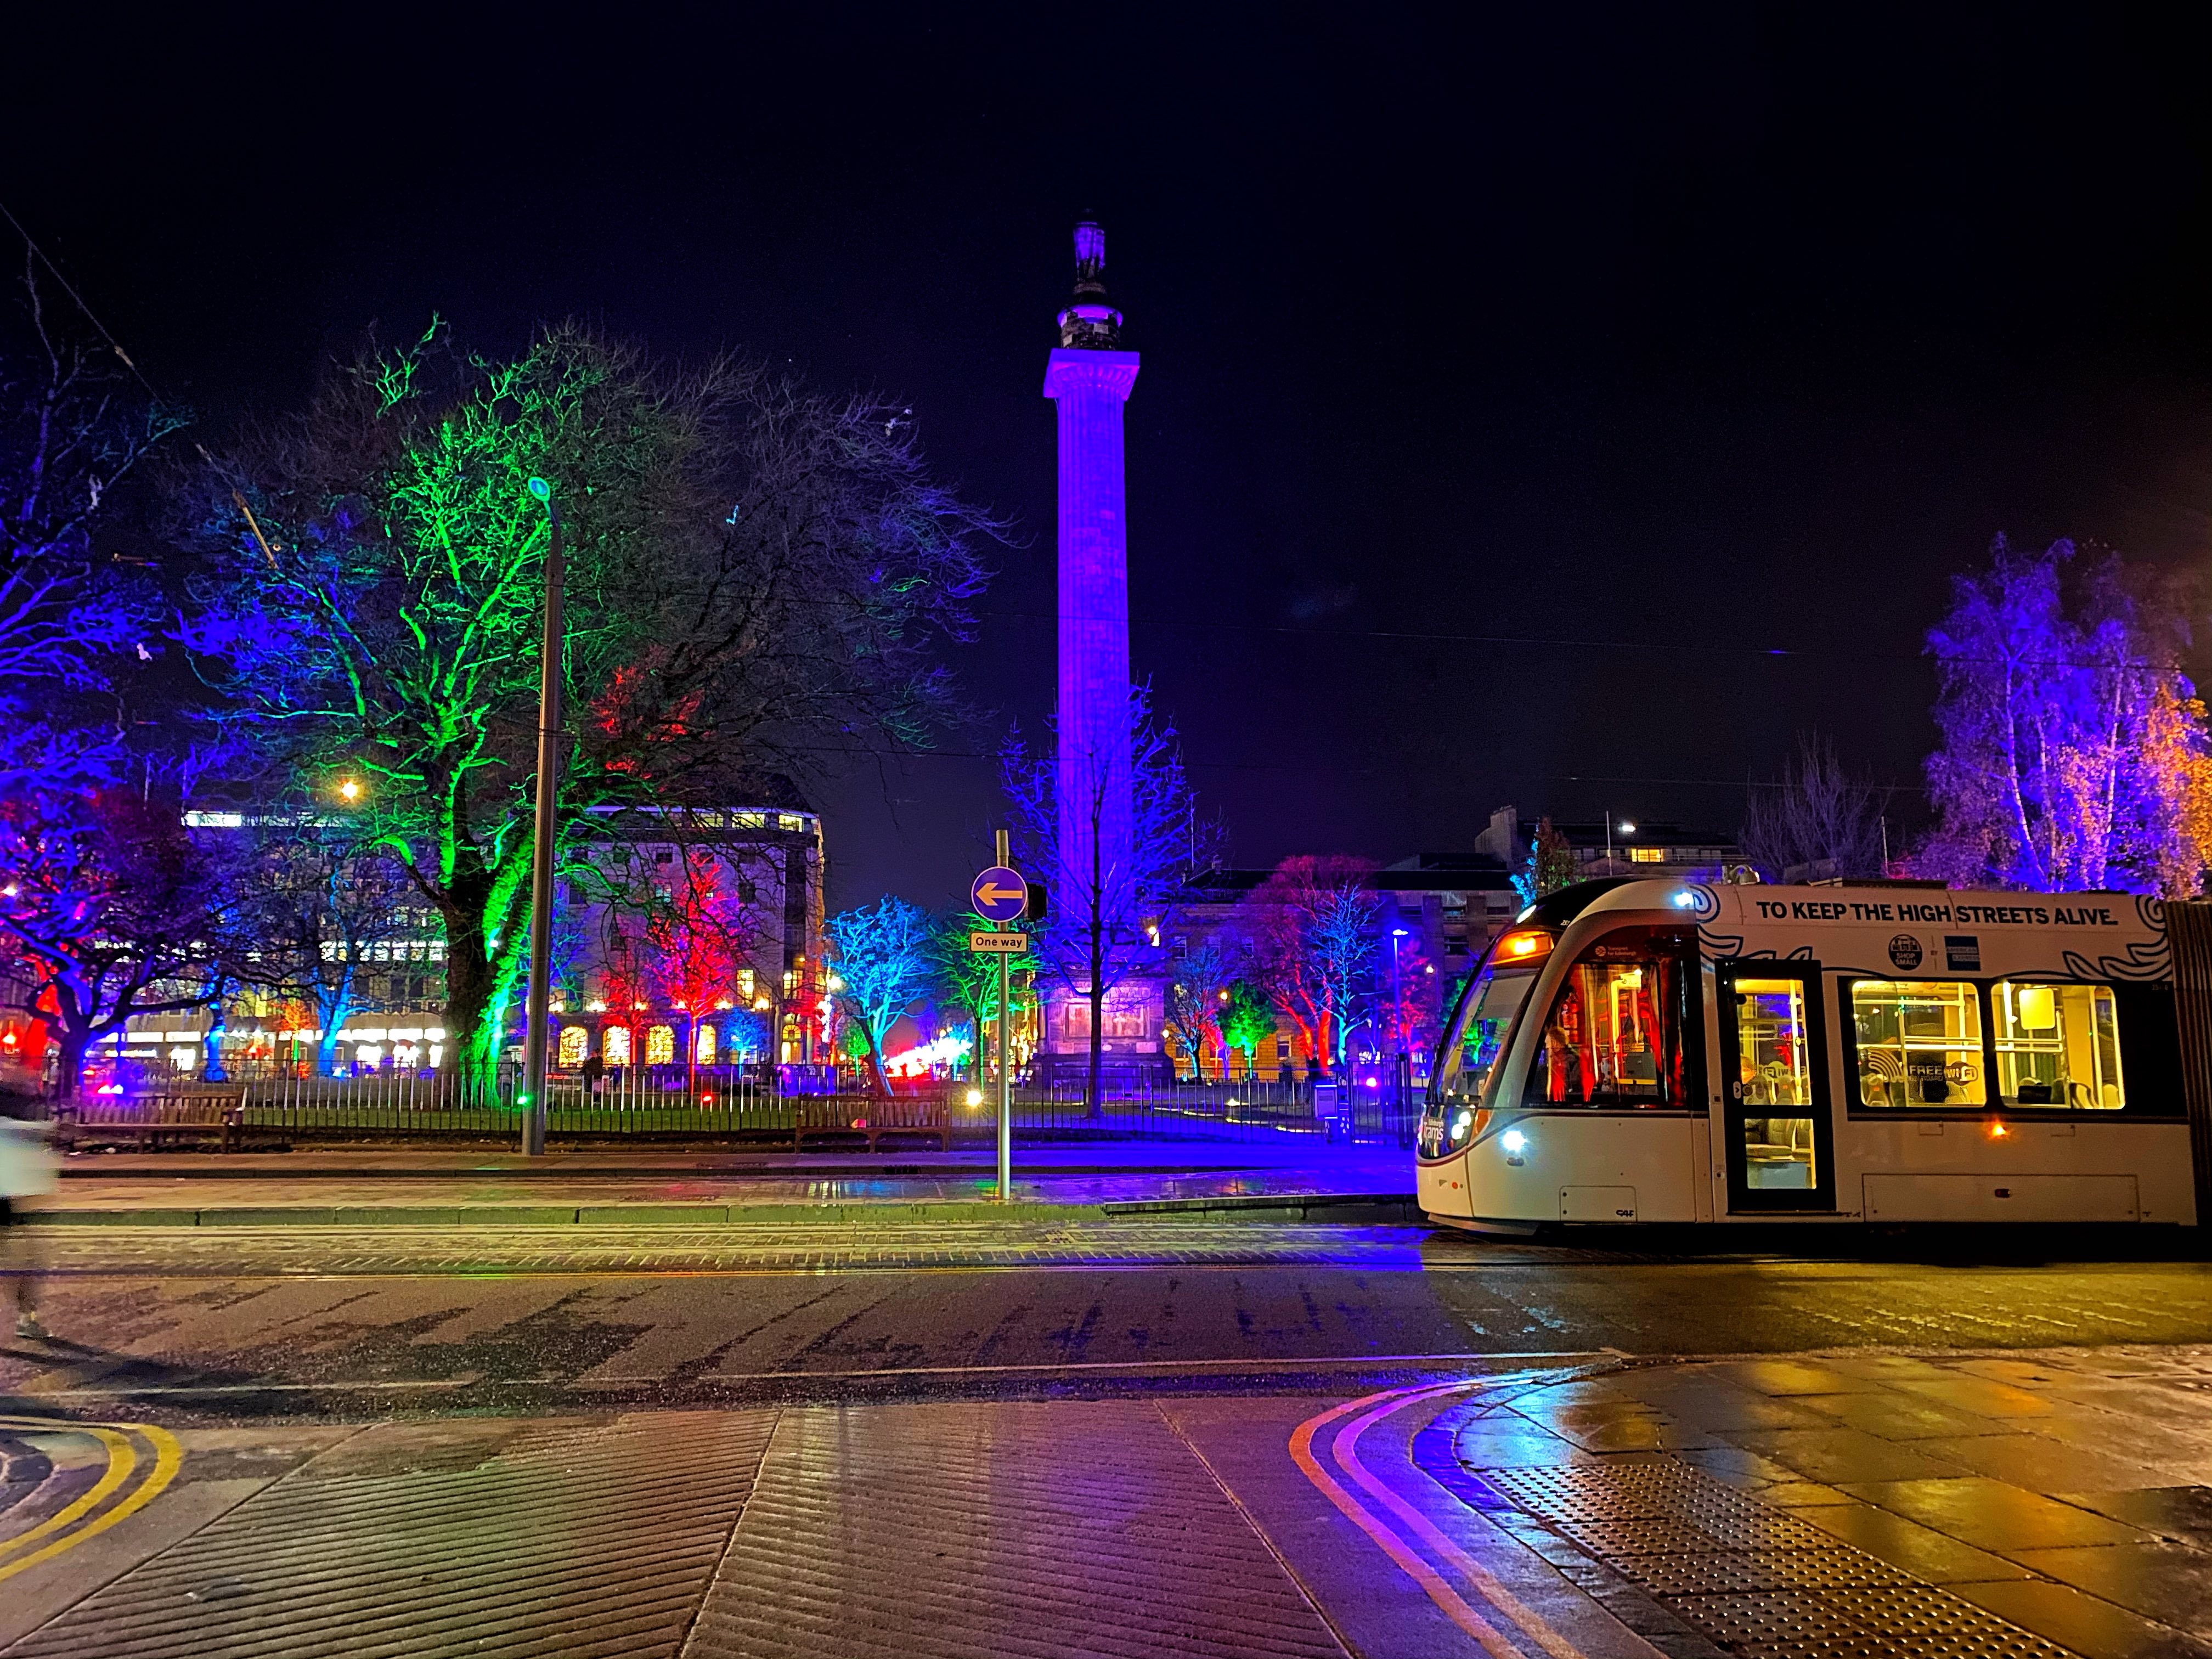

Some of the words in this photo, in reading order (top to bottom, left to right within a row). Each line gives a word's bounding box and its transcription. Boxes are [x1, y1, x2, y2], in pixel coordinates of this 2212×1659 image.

[1756, 901, 1787, 919] TO
[1791, 902, 1847, 920] KEEP
[1849, 904, 1894, 921] THE
[1897, 904, 1951, 922] HIGH
[1956, 906, 2050, 924] STREETS
[975, 936, 998, 946] One
[1001, 939, 1023, 949] way
[1909, 1065, 1943, 1075] FREE
[1424, 1122, 1444, 1141] Trams
